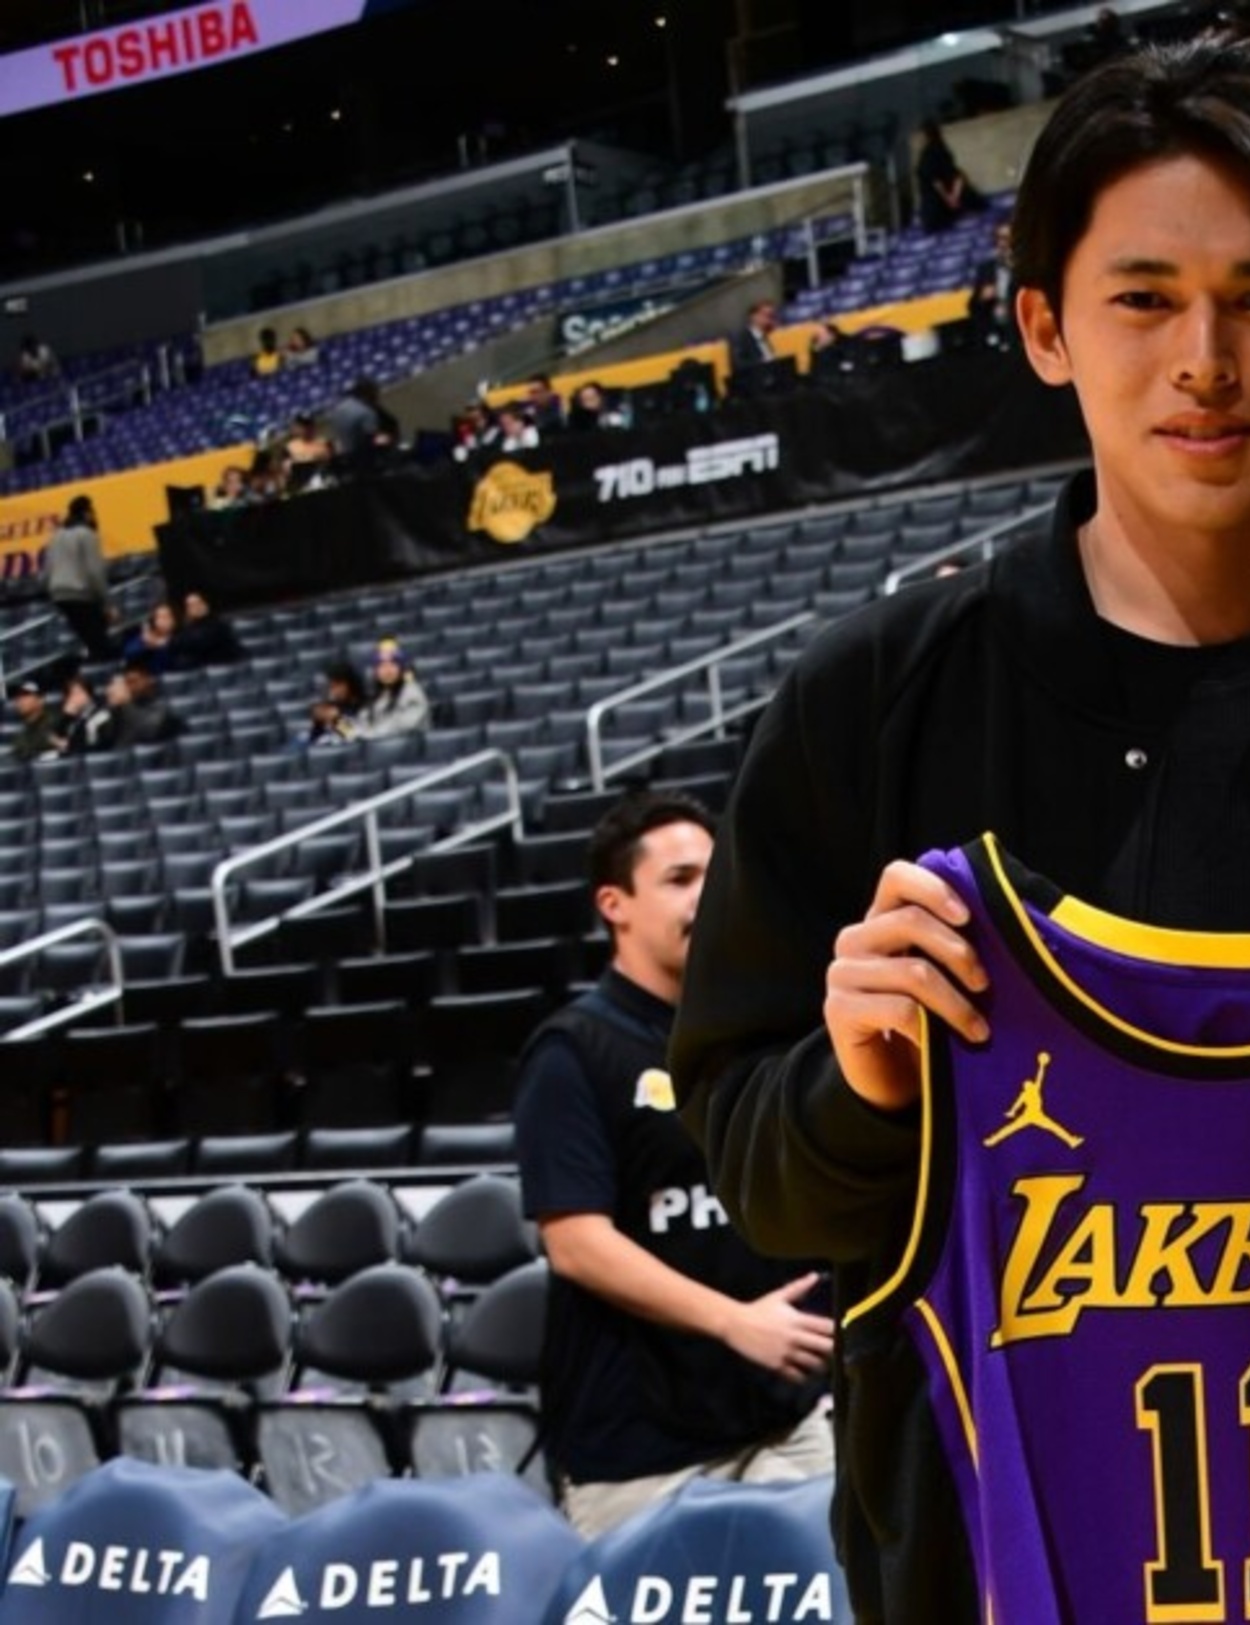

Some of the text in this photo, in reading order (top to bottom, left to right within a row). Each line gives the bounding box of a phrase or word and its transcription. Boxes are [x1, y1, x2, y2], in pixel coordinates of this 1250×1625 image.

[53, 0, 259, 91] TOSHIBA
[594, 458, 652, 501] 710
[687, 433, 778, 483] ESPN
[18, 1421, 64, 1486] 10
[61, 1542, 209, 1600] DELTA
[320, 1552, 500, 1609] DELTA
[631, 1573, 832, 1624] DELTA
